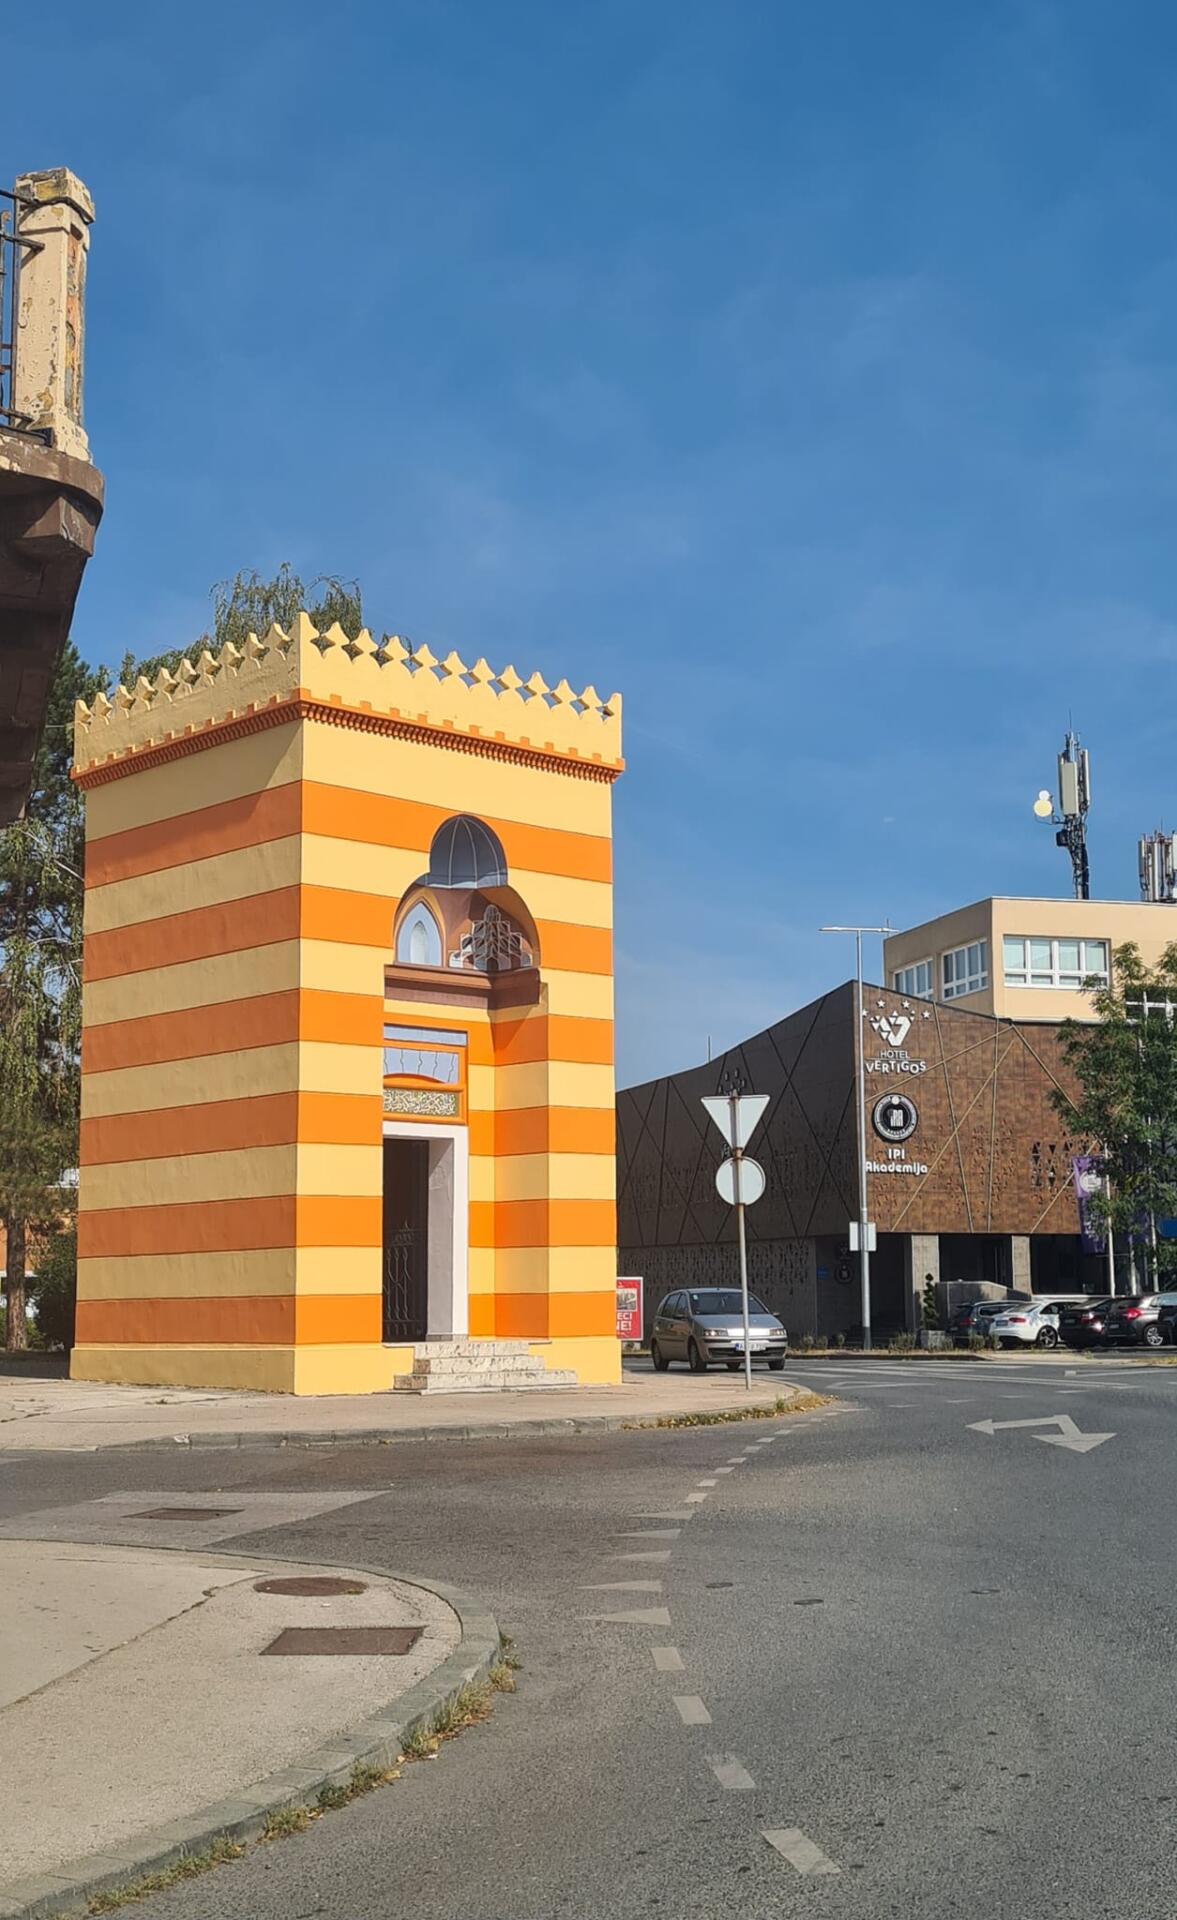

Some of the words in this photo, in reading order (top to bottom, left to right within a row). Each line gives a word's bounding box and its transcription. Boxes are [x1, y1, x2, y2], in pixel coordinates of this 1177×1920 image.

[880, 1050, 910, 1059] HOTEL
[865, 1060, 927, 1074] VERTIGOS
[888, 1148, 905, 1160] IPI
[865, 1161, 928, 1176] Akademija
